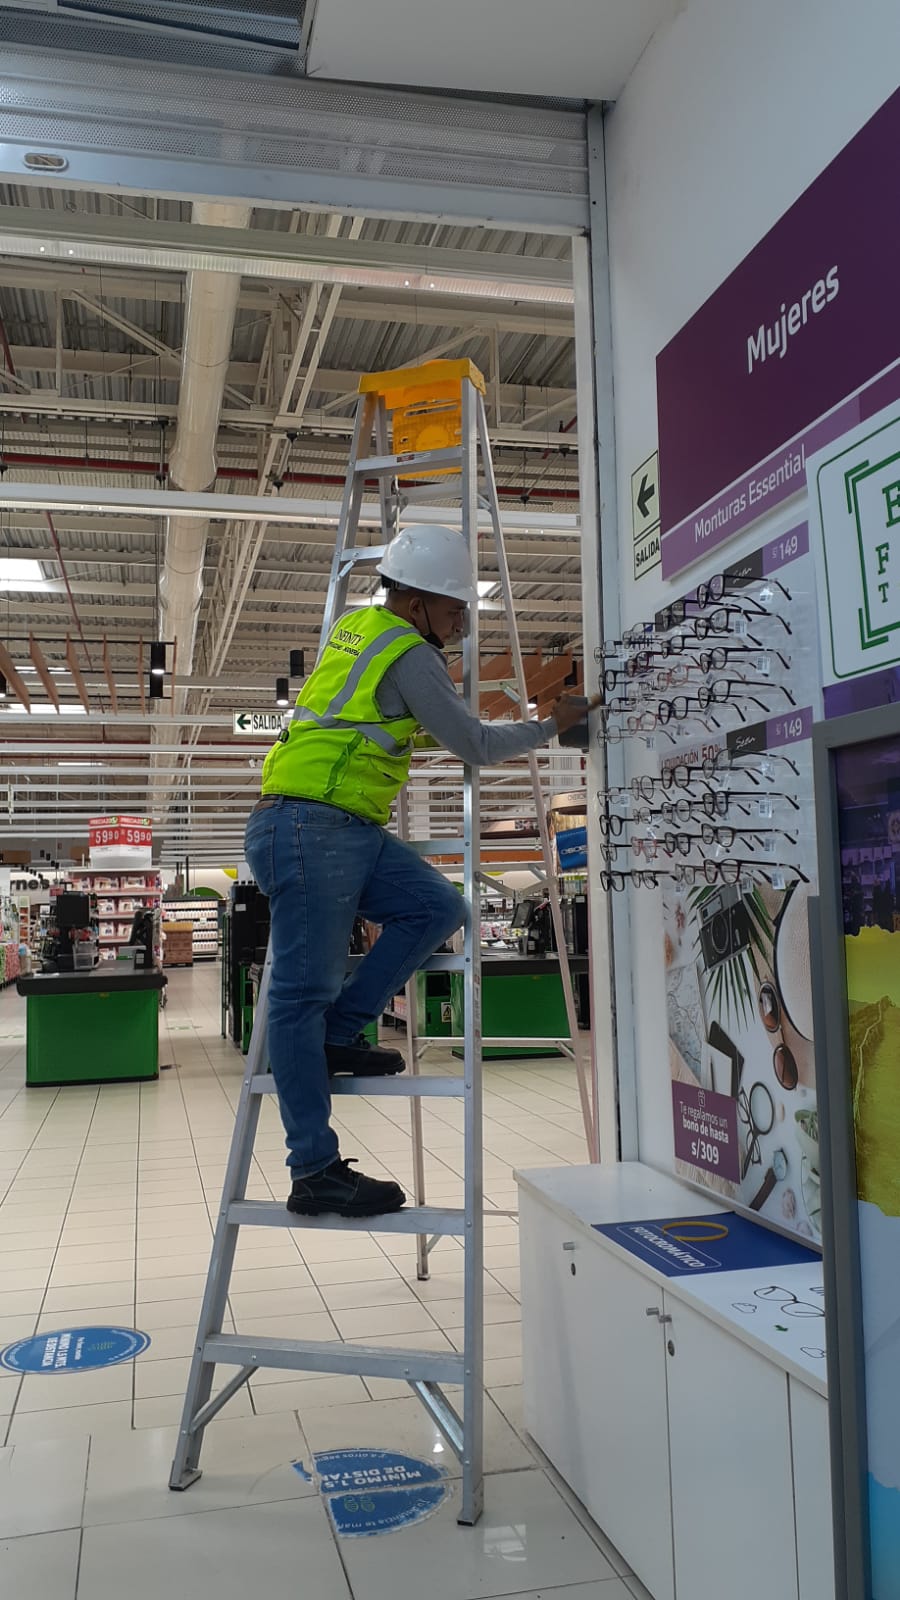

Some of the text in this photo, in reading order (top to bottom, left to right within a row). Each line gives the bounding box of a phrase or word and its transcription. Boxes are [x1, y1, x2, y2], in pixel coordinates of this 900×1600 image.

[747, 265, 840, 374] Mujeres
[695, 443, 805, 543] Monturas Essential
[636, 536, 660, 567] SALIDA
[780, 535, 798, 560] 149
[875, 542, 889, 575] F
[878, 582, 889, 604] T
[253, 714, 282, 730] SALIDA
[783, 717, 803, 739] 149
[683, 1114, 729, 1144] bono de hasta
[688, 1106, 718, 1126] regalamos
[719, 1118, 728, 1129] un
[691, 1138, 719, 1165] s/309
[354, 1471, 422, 1485] MÍNIMO
[383, 1465, 406, 1474] DE
[324, 1480, 349, 1488] 1.5
